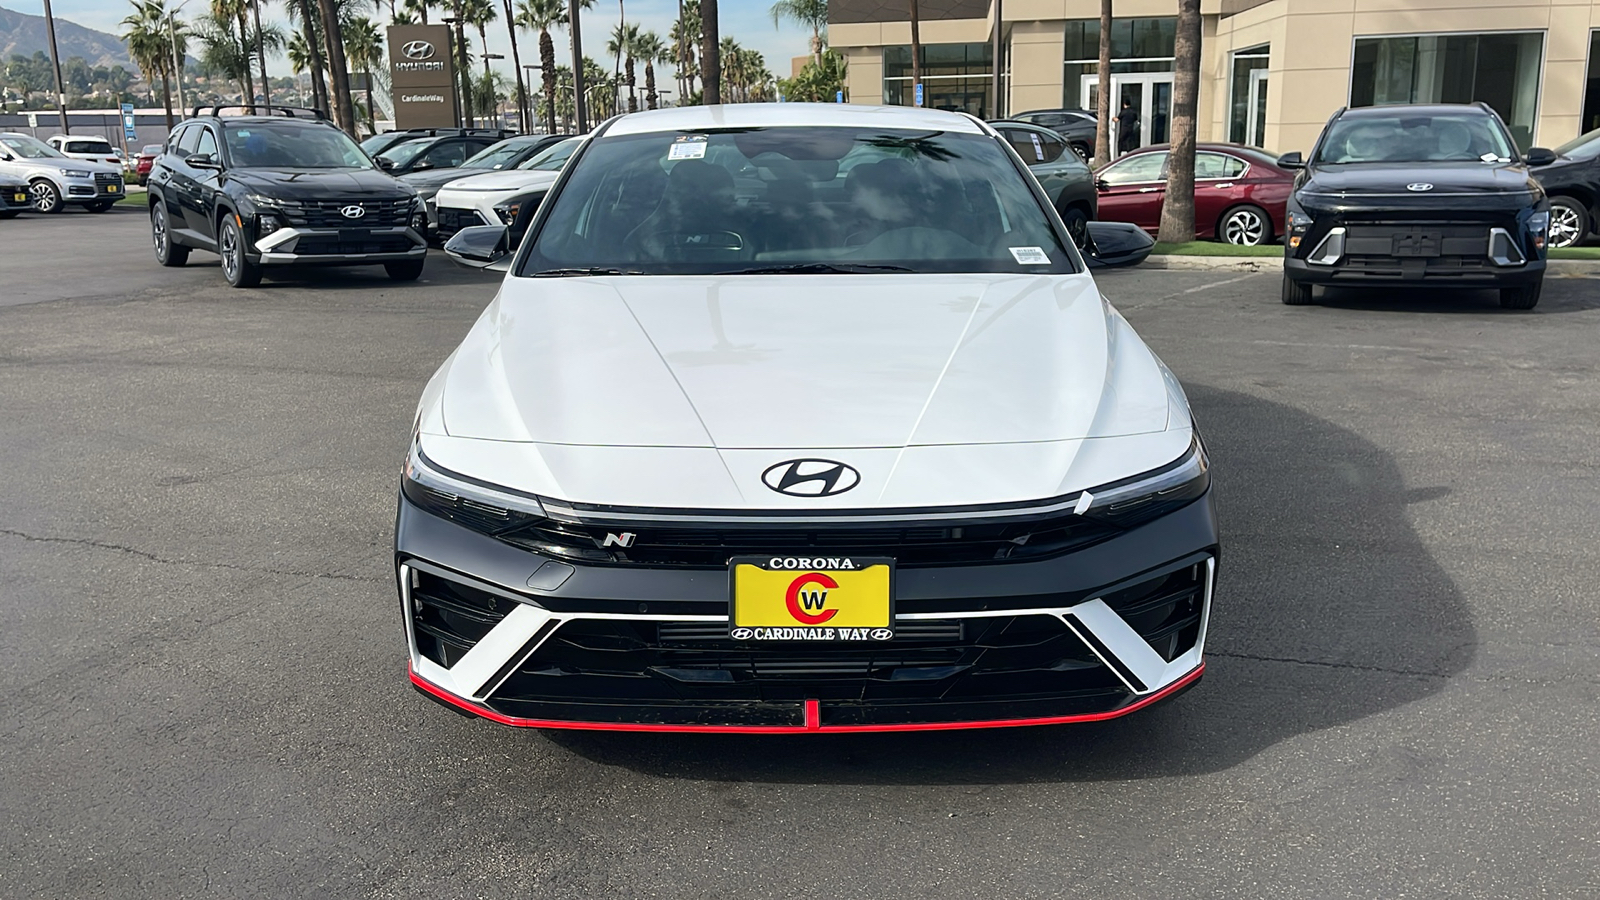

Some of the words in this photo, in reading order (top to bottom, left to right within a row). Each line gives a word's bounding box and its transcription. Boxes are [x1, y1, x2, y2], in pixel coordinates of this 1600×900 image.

[395, 62, 444, 71] HYUNDAI
[401, 94, 444, 103] CardinaleWay
[769, 557, 855, 569] CORONA
[754, 627, 835, 640] CARDINALE
[839, 628, 870, 640] WAY
